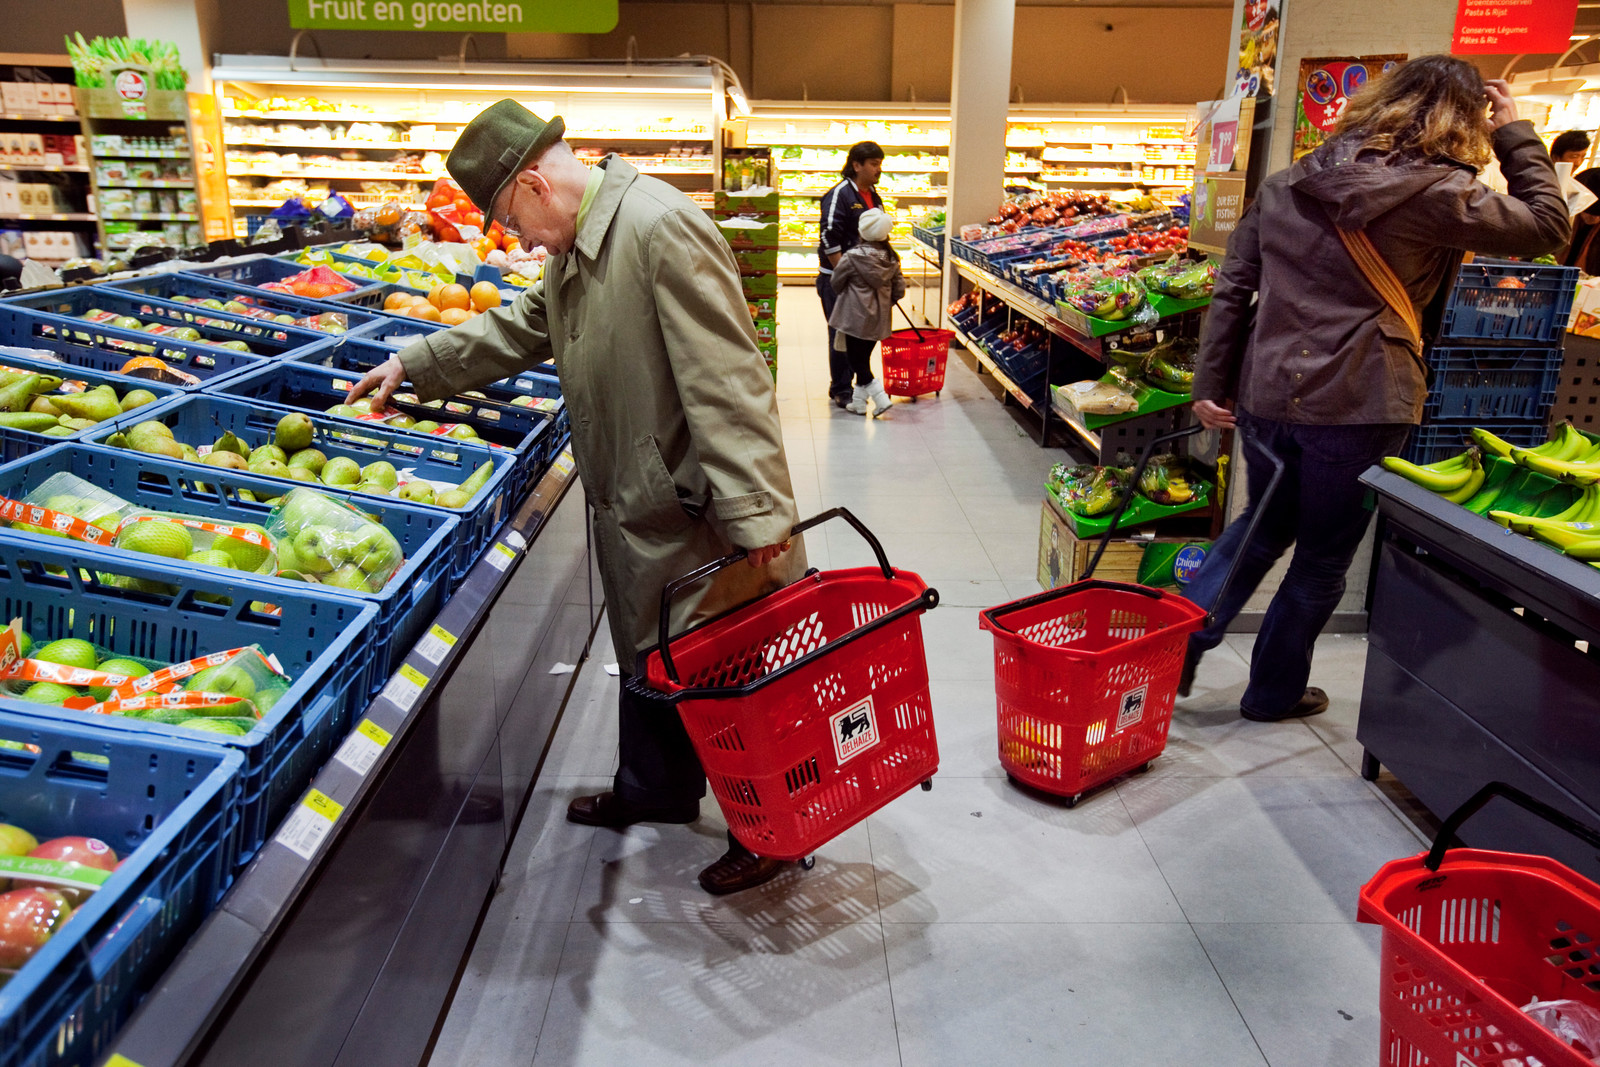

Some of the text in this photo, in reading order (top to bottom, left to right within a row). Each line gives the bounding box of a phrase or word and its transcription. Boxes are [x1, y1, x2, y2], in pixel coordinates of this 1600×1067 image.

[308, 0, 523, 28] Fruit en groenten
[1464, 8, 1484, 16] Pasta
[1492, 8, 1508, 17] Rijst
[1461, 26, 1528, 35] Conserves Légumes
[1459, 36, 1479, 44] Pâtes
[1487, 36, 1498, 44] Riz
[841, 729, 872, 755] DELHAIZE
